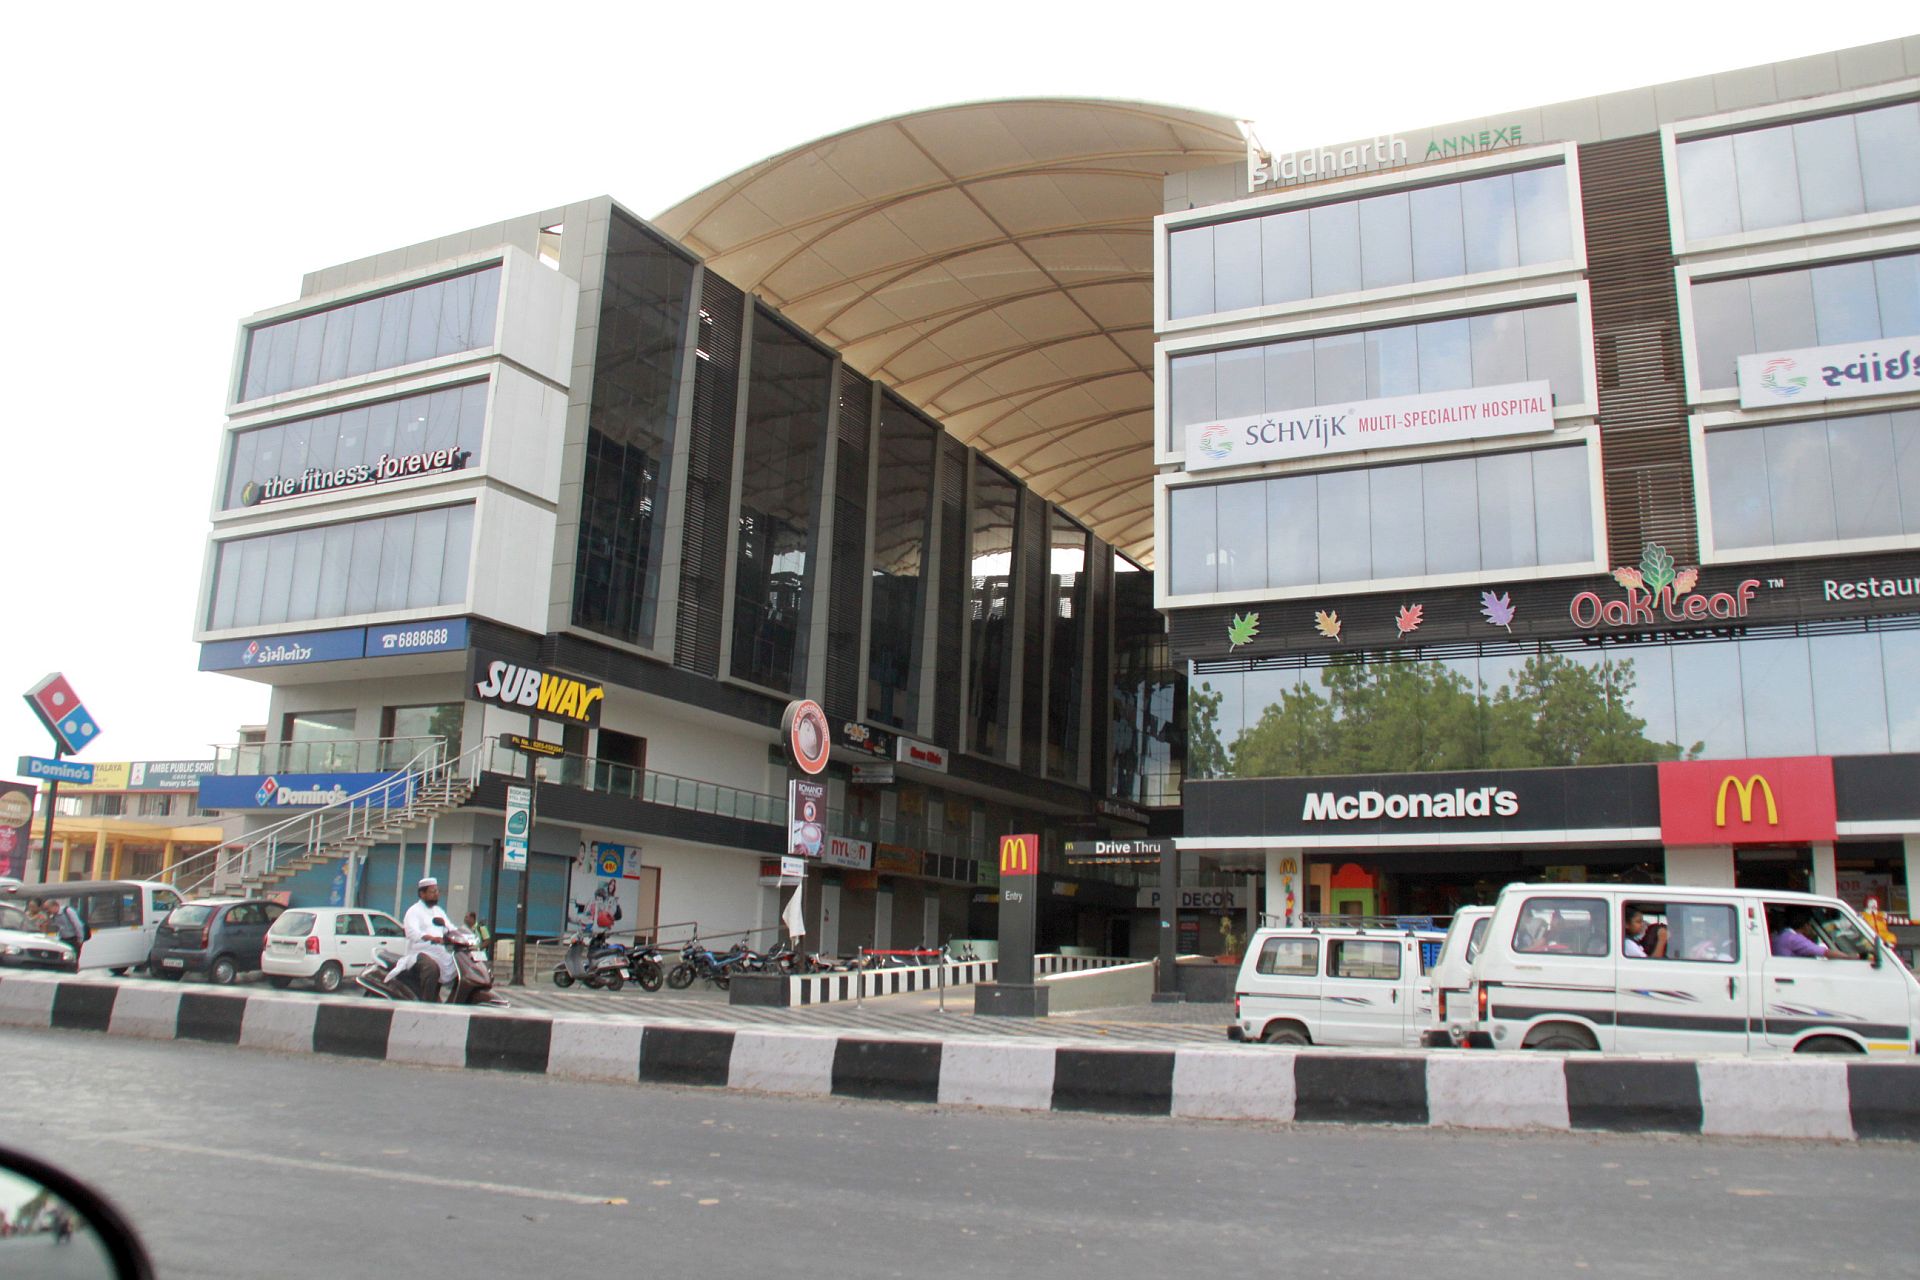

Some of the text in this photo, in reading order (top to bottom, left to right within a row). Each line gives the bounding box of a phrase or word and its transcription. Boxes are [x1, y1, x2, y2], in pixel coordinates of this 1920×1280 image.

[1427, 125, 1522, 153] ANNEXE
[1359, 404, 1477, 433] MULTI-SPECIALITY
[1482, 396, 1546, 419] HOSPITAL
[264, 446, 460, 499] the fitness forever
[1569, 587, 1655, 630] Oak
[1661, 578, 1761, 623] Leaf
[397, 628, 449, 648] 6888688
[475, 660, 605, 721] SUBWAY
[29, 757, 92, 781] Domino's
[169, 762, 196, 774] PUBLIC
[276, 783, 349, 806] Domino's
[1301, 785, 1519, 821] McDonald's
[1095, 841, 1131, 854] Drive
[1133, 840, 1161, 854] Thru
[1005, 890, 1023, 903] Entry
[1182, 891, 1235, 907] DECOR
